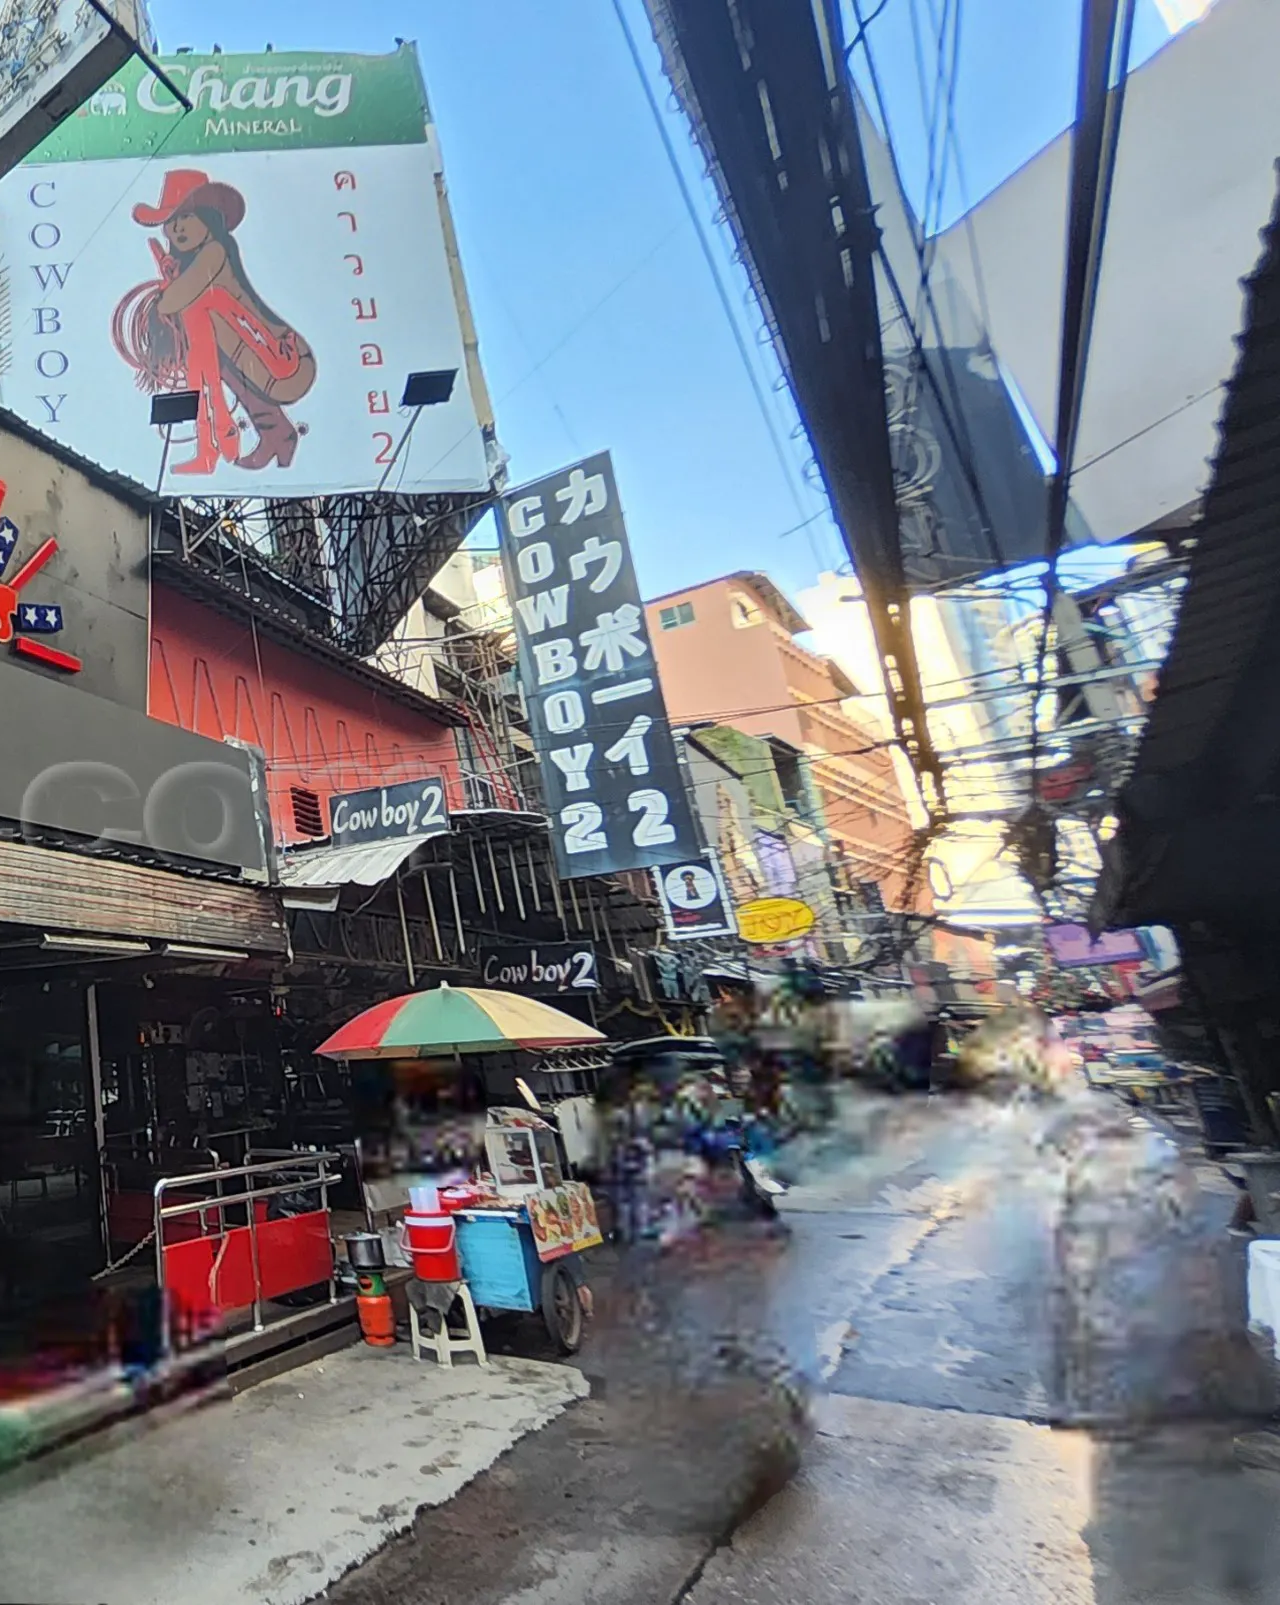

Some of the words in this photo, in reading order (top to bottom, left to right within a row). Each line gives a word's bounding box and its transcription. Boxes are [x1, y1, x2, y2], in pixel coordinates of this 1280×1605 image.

[136, 63, 353, 118] Chang
[204, 117, 302, 137] MINERAL
[28, 181, 74, 423] COWBOY
